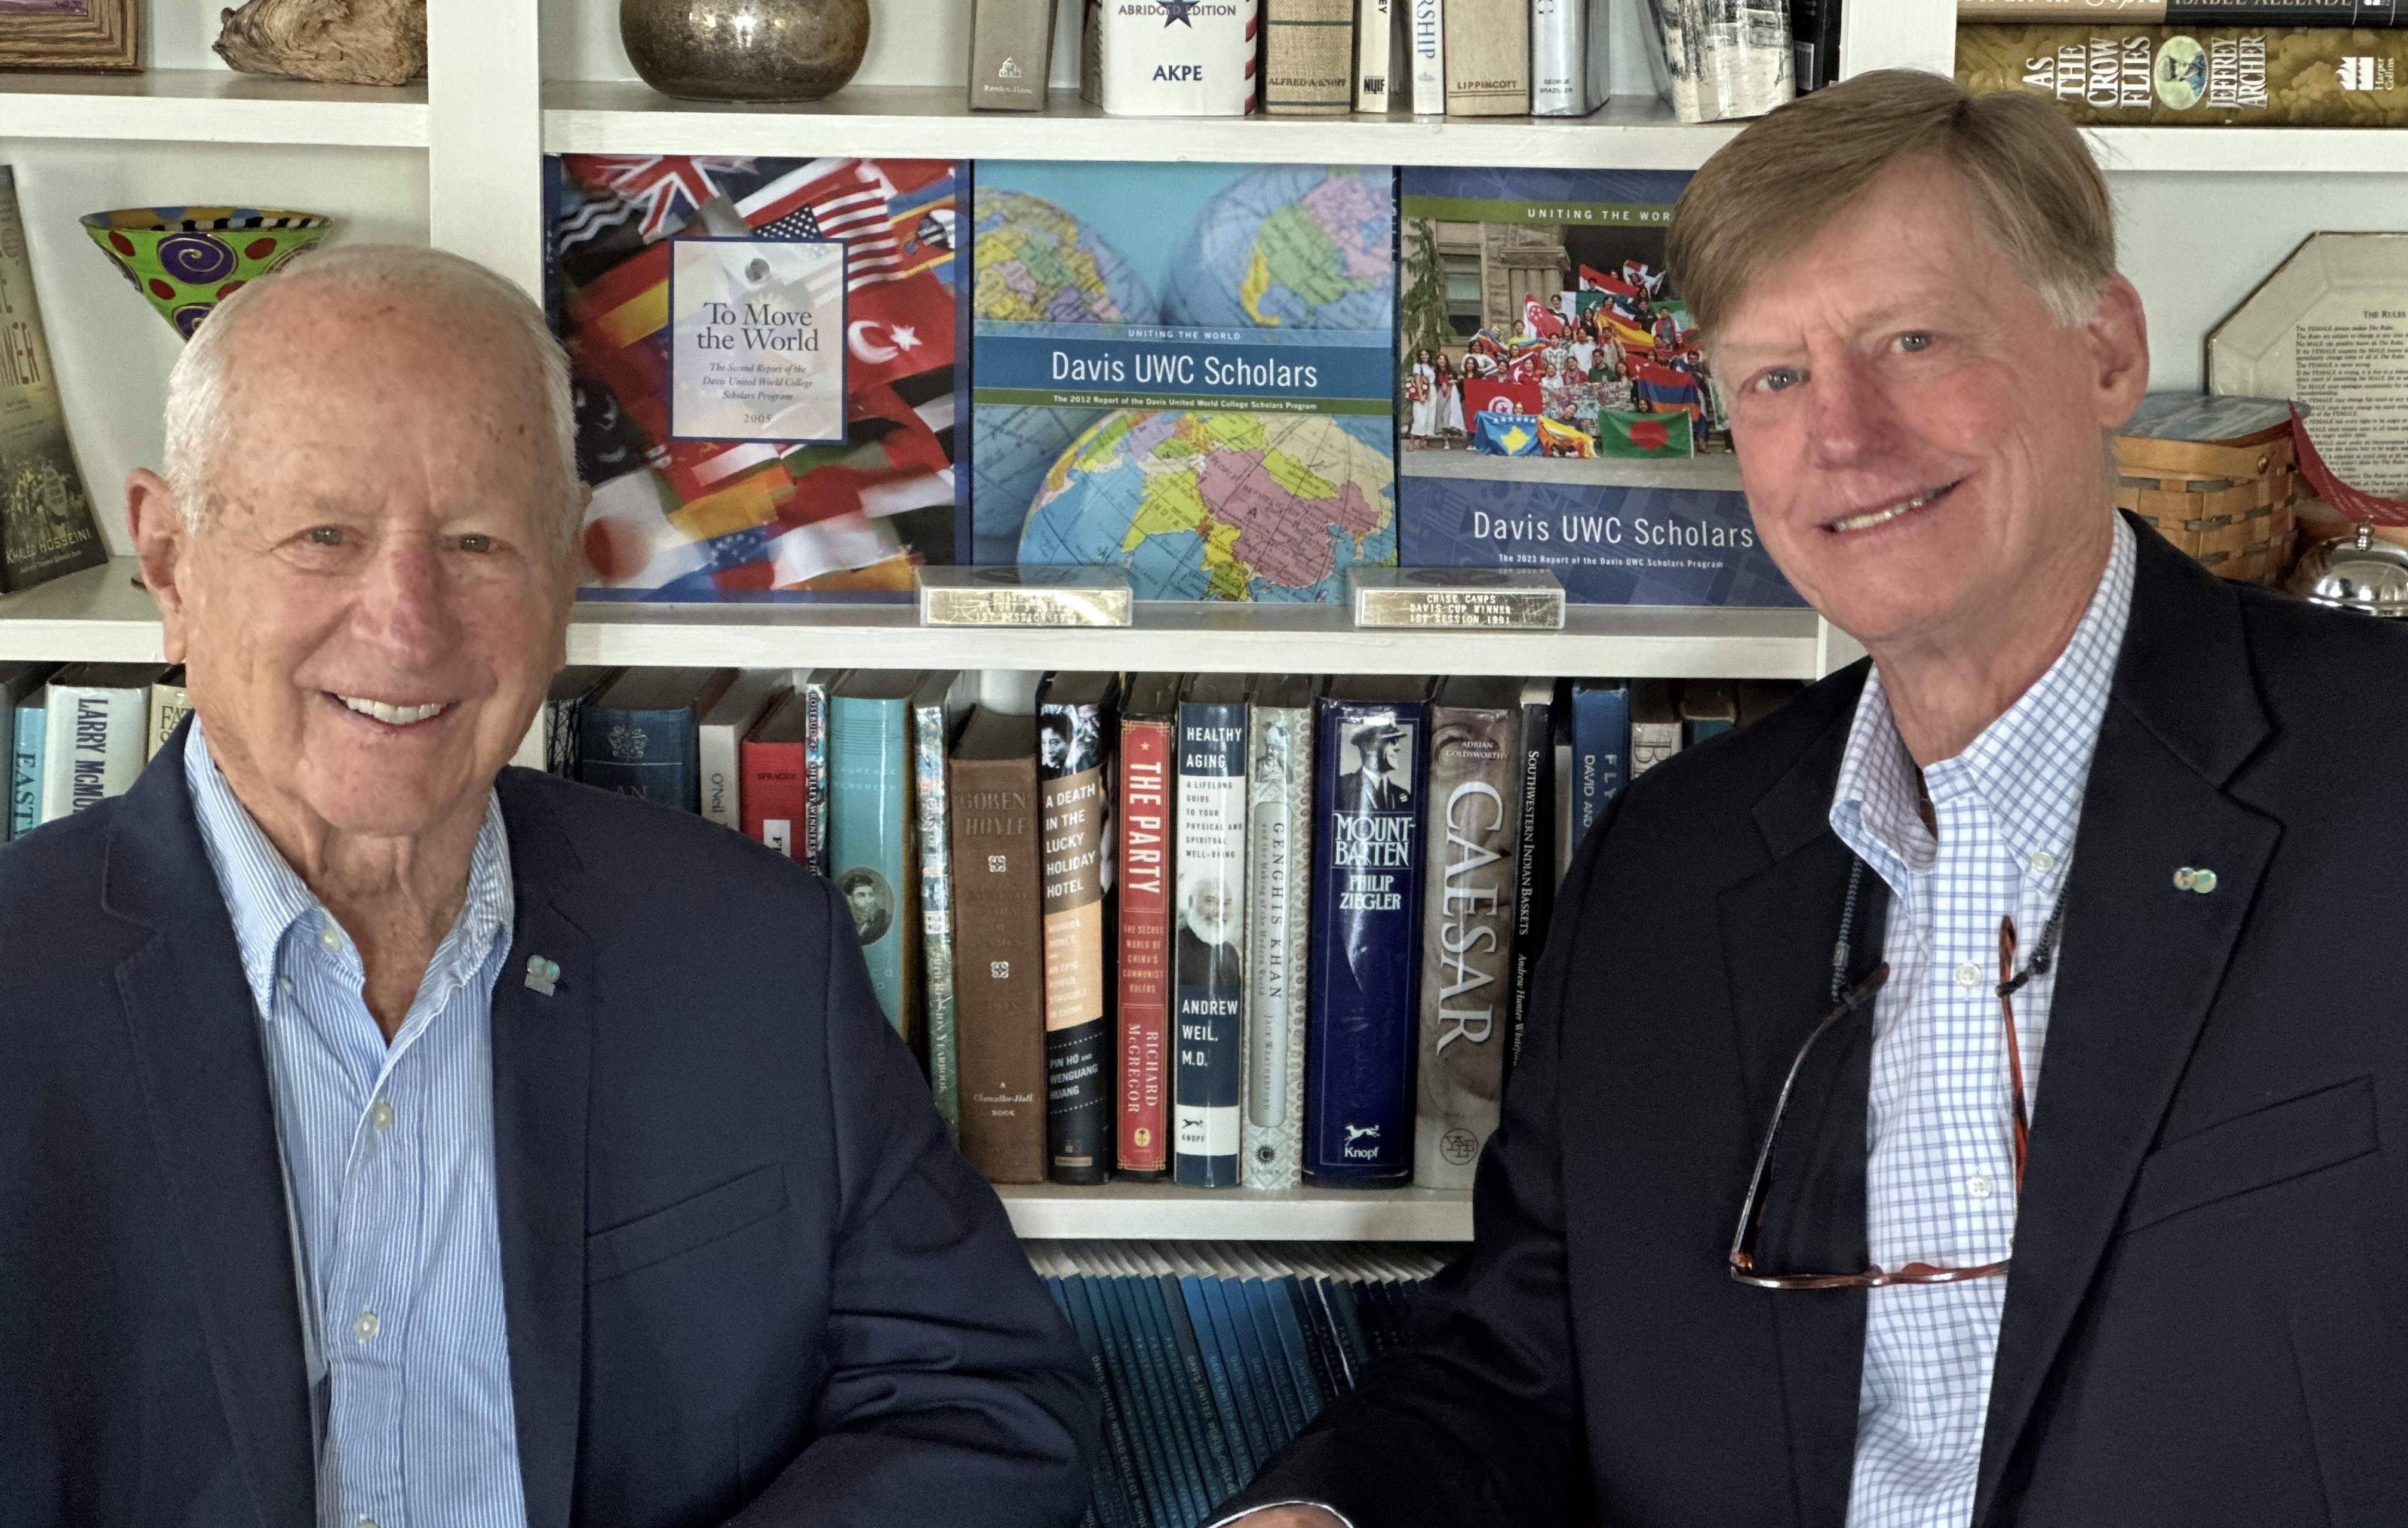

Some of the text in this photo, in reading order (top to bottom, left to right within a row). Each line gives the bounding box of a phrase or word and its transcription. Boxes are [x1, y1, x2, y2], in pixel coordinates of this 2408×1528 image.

[1153, 65, 1203, 82] AKPE
[2022, 57, 2054, 89] AS
[2057, 45, 2087, 100] THE
[2087, 38, 2120, 108] CROW
[2120, 36, 2152, 109] FLIES
[2207, 38, 2241, 110] JEFFREY
[2237, 35, 2268, 109] ARCHER
[2375, 58, 2386, 90] Harper
[2384, 57, 2394, 90] Collins
[1457, 81, 1517, 90] LIPPINCOTT
[1528, 208, 1630, 220] UNITING THE
[703, 302, 812, 327] To Move
[697, 326, 819, 351] the World
[1128, 330, 1174, 338] UNITING
[1204, 332, 1241, 340] WORLD
[710, 362, 806, 375] The Second Report of the
[1053, 352, 1317, 388] Davis UWC Scholars
[702, 376, 813, 388] Davis United World College
[723, 391, 793, 402] Scholars Program
[1094, 396, 1119, 406] Report
[1221, 401, 1248, 410] College
[1286, 402, 1317, 411] Program
[1474, 511, 1753, 548] Davis UWC Scholars
[6, 543, 36, 564] KHALED
[39, 528, 91, 554] HOSSEINI
[1499, 554, 1514, 562] The
[1540, 556, 1568, 566] Report
[1572, 557, 1581, 565] of
[1583, 557, 1597, 565] the
[1601, 558, 1623, 566] Davis
[1626, 558, 1644, 567] UWC
[1647, 559, 1685, 568] Scholars
[1687, 560, 1724, 570] Program
[1427, 595, 1496, 604] CHASE CAMPS
[1409, 604, 1511, 615] DAVIS CUP WINNER
[1410, 614, 1510, 625] 1ST SESSION 1991
[809, 693, 818, 736] ROSEBUD
[76, 698, 109, 754] LARRY
[1187, 727, 1242, 742] HEALTHY
[1186, 754, 1226, 769] AGING
[1446, 751, 1507, 760] GOLDSWORTHY
[809, 763, 818, 803] SHELLEY
[1195, 781, 1233, 789] LIFELONG
[1583, 755, 1596, 828] DAVID AND
[960, 792, 1027, 810] GOREN
[1045, 783, 1096, 808] A DEATH
[1187, 795, 1209, 803] GUIDE
[1046, 810, 1085, 831] IN THE
[1199, 809, 1219, 817] YOUR
[965, 817, 1027, 836] HOYLE
[1128, 761, 1162, 894] THE PARTY
[1186, 822, 1243, 831] PHYSICAL AND
[1333, 813, 1415, 841] MOUNT-
[1046, 832, 1085, 854] LUCKY
[1186, 837, 1227, 845] SPIRITUAL
[1186, 850, 1235, 859] WELL-BEING
[1335, 840, 1409, 866] BATTEN
[1046, 850, 1096, 876] HOLIDAY
[1259, 862, 1267, 896] Making
[1350, 875, 1394, 892] PHILIP
[1515, 751, 1540, 1022] SOUTHWESTERN INDIAN BASKETS Andrew Hunter
[1046, 880, 1084, 899] HOTEL
[1269, 822, 1285, 998] GENGHIS KHAN
[1340, 894, 1401, 909] ZIEGLER
[1437, 781, 1503, 1056] CAESAR
[1123, 924, 1164, 936] THE SECRET
[1126, 939, 1162, 949] WORLD OF
[1127, 954, 1158, 965] CHINA'S
[1122, 969, 1164, 980] COMMUNIST
[1129, 983, 1156, 994] RULERS
[1182, 1000, 1238, 1015] ANDREW
[1182, 1025, 1218, 1042] WEIL,
[1049, 1054, 1079, 1069] PIN HO
[1182, 1050, 1208, 1066] M.D.
[1263, 1015, 1274, 1110] JACK WEATHERFORD
[1049, 1063, 1098, 1085] WENGUANG
[1145, 1031, 1159, 1108] RICHARD
[1049, 1086, 1079, 1100] HUANG
[1182, 1135, 1205, 1143] KNOPF
[1443, 1136, 1478, 1158] YALE
[1344, 1147, 1379, 1160] Knopf
